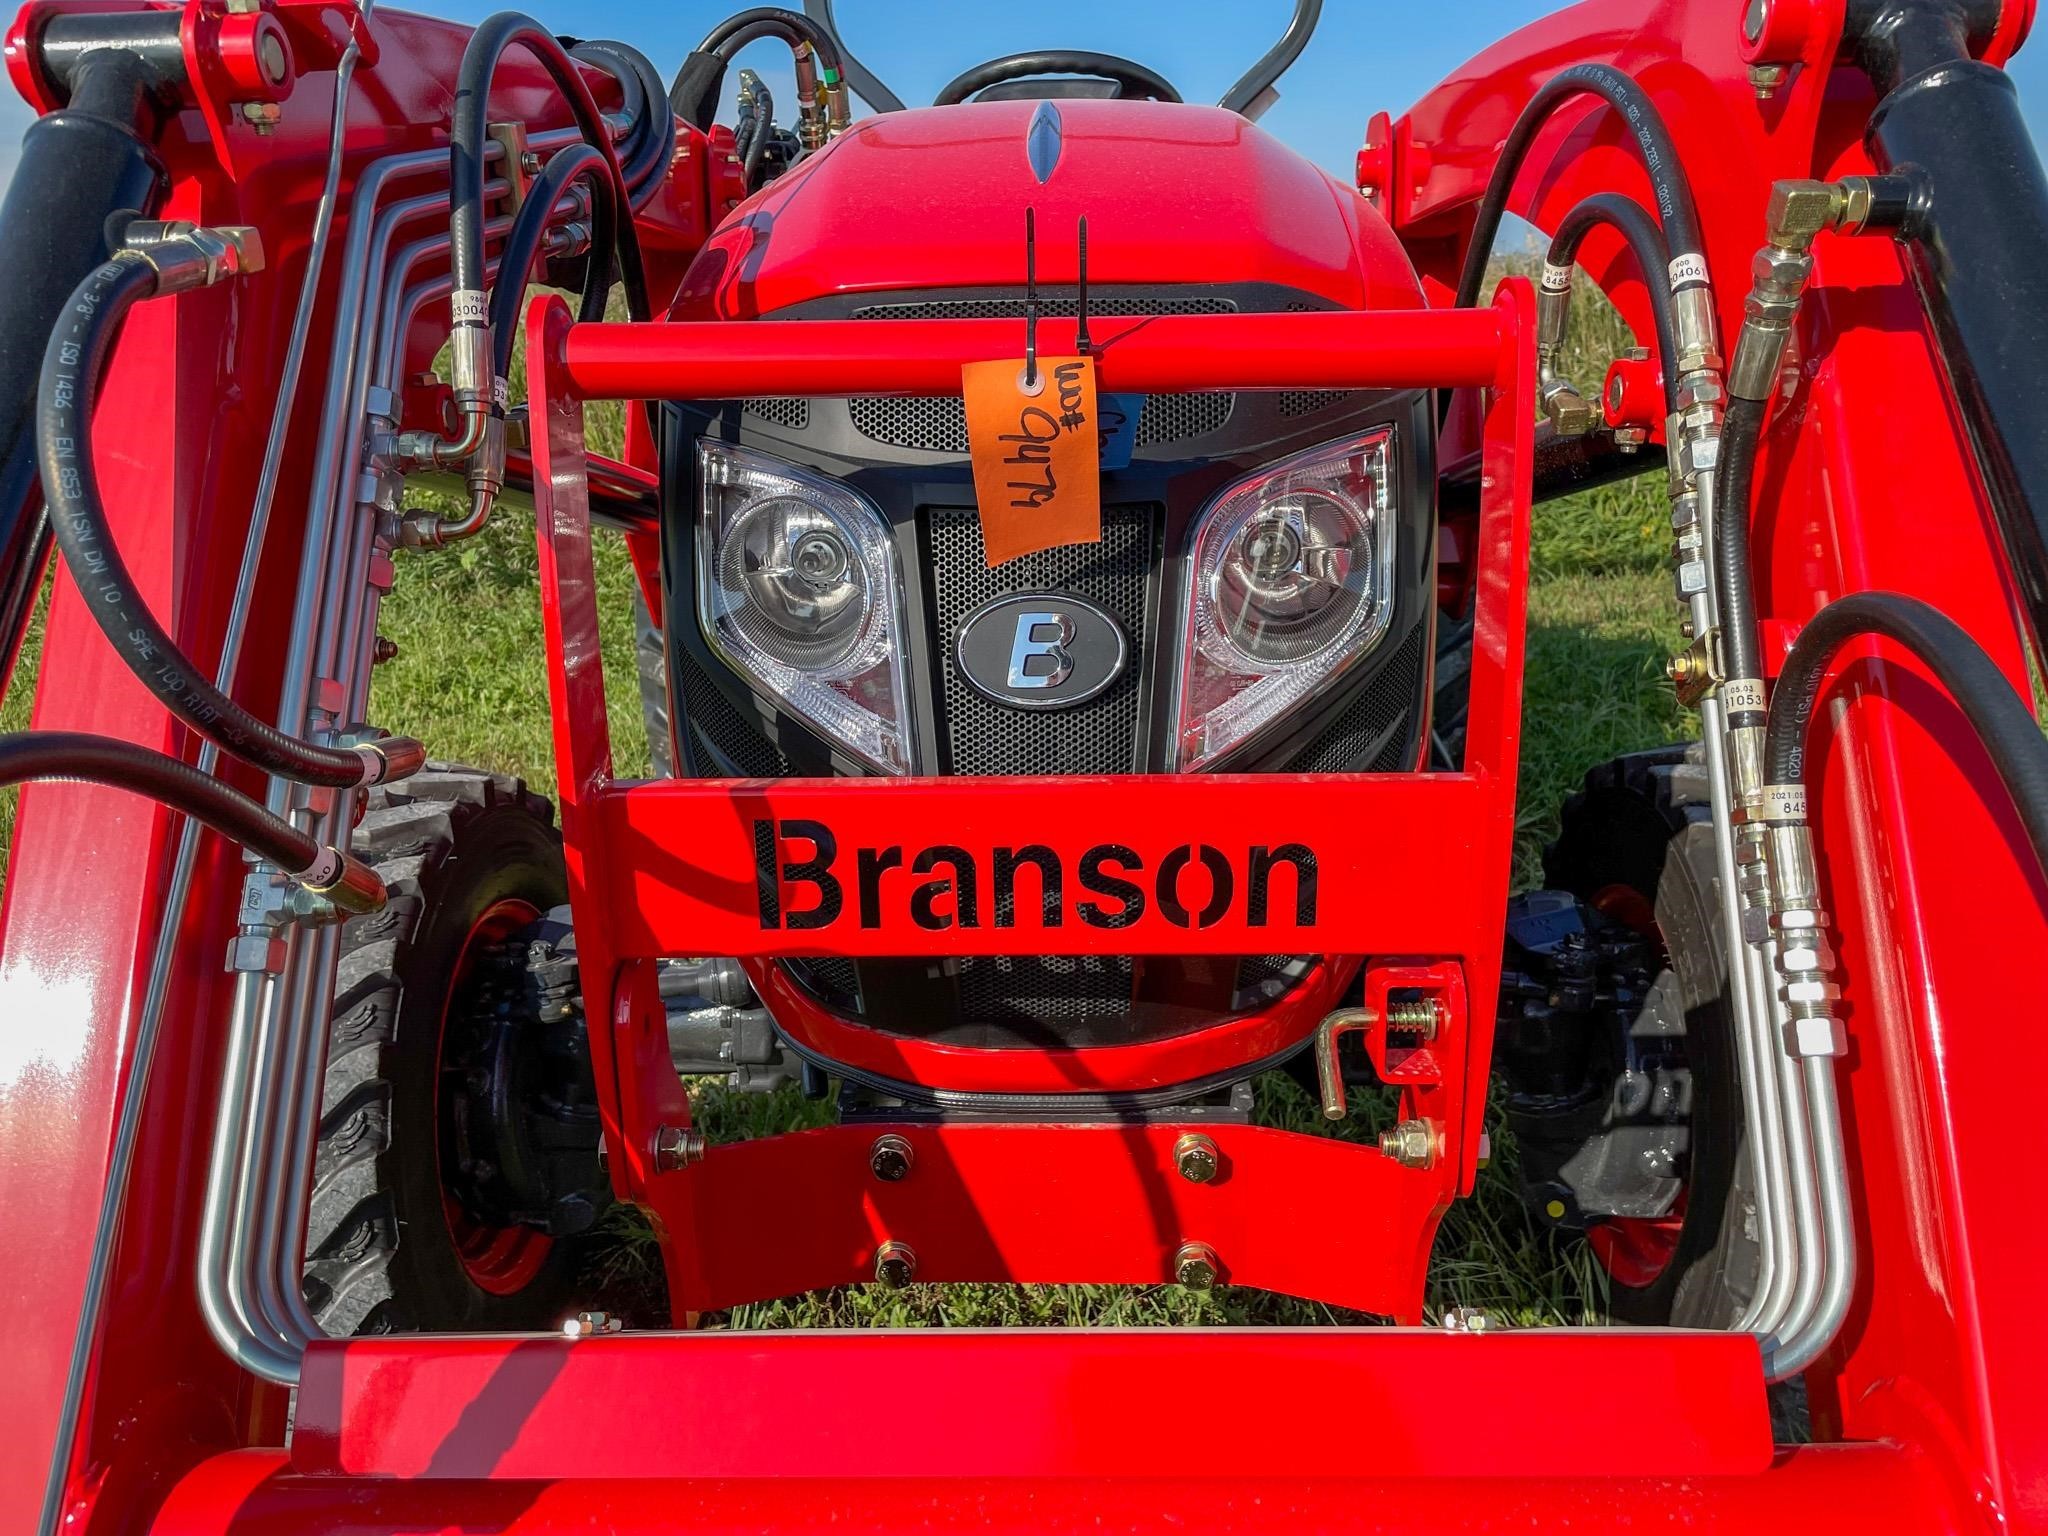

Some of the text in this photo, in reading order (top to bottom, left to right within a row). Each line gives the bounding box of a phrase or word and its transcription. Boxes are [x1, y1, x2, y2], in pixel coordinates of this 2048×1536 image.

[59, 341, 81, 365] ISO
[54, 374, 76, 409] 1436
[55, 437, 76, 459] EN
[998, 406, 1060, 508] 9479
[60, 467, 83, 500] 853
[83, 551, 109, 575] DN
[99, 582, 123, 604] 10
[128, 628, 160, 661] SAE
[1007, 612, 1077, 688] B
[155, 664, 186, 691] 100
[753, 818, 1318, 931] Branson
